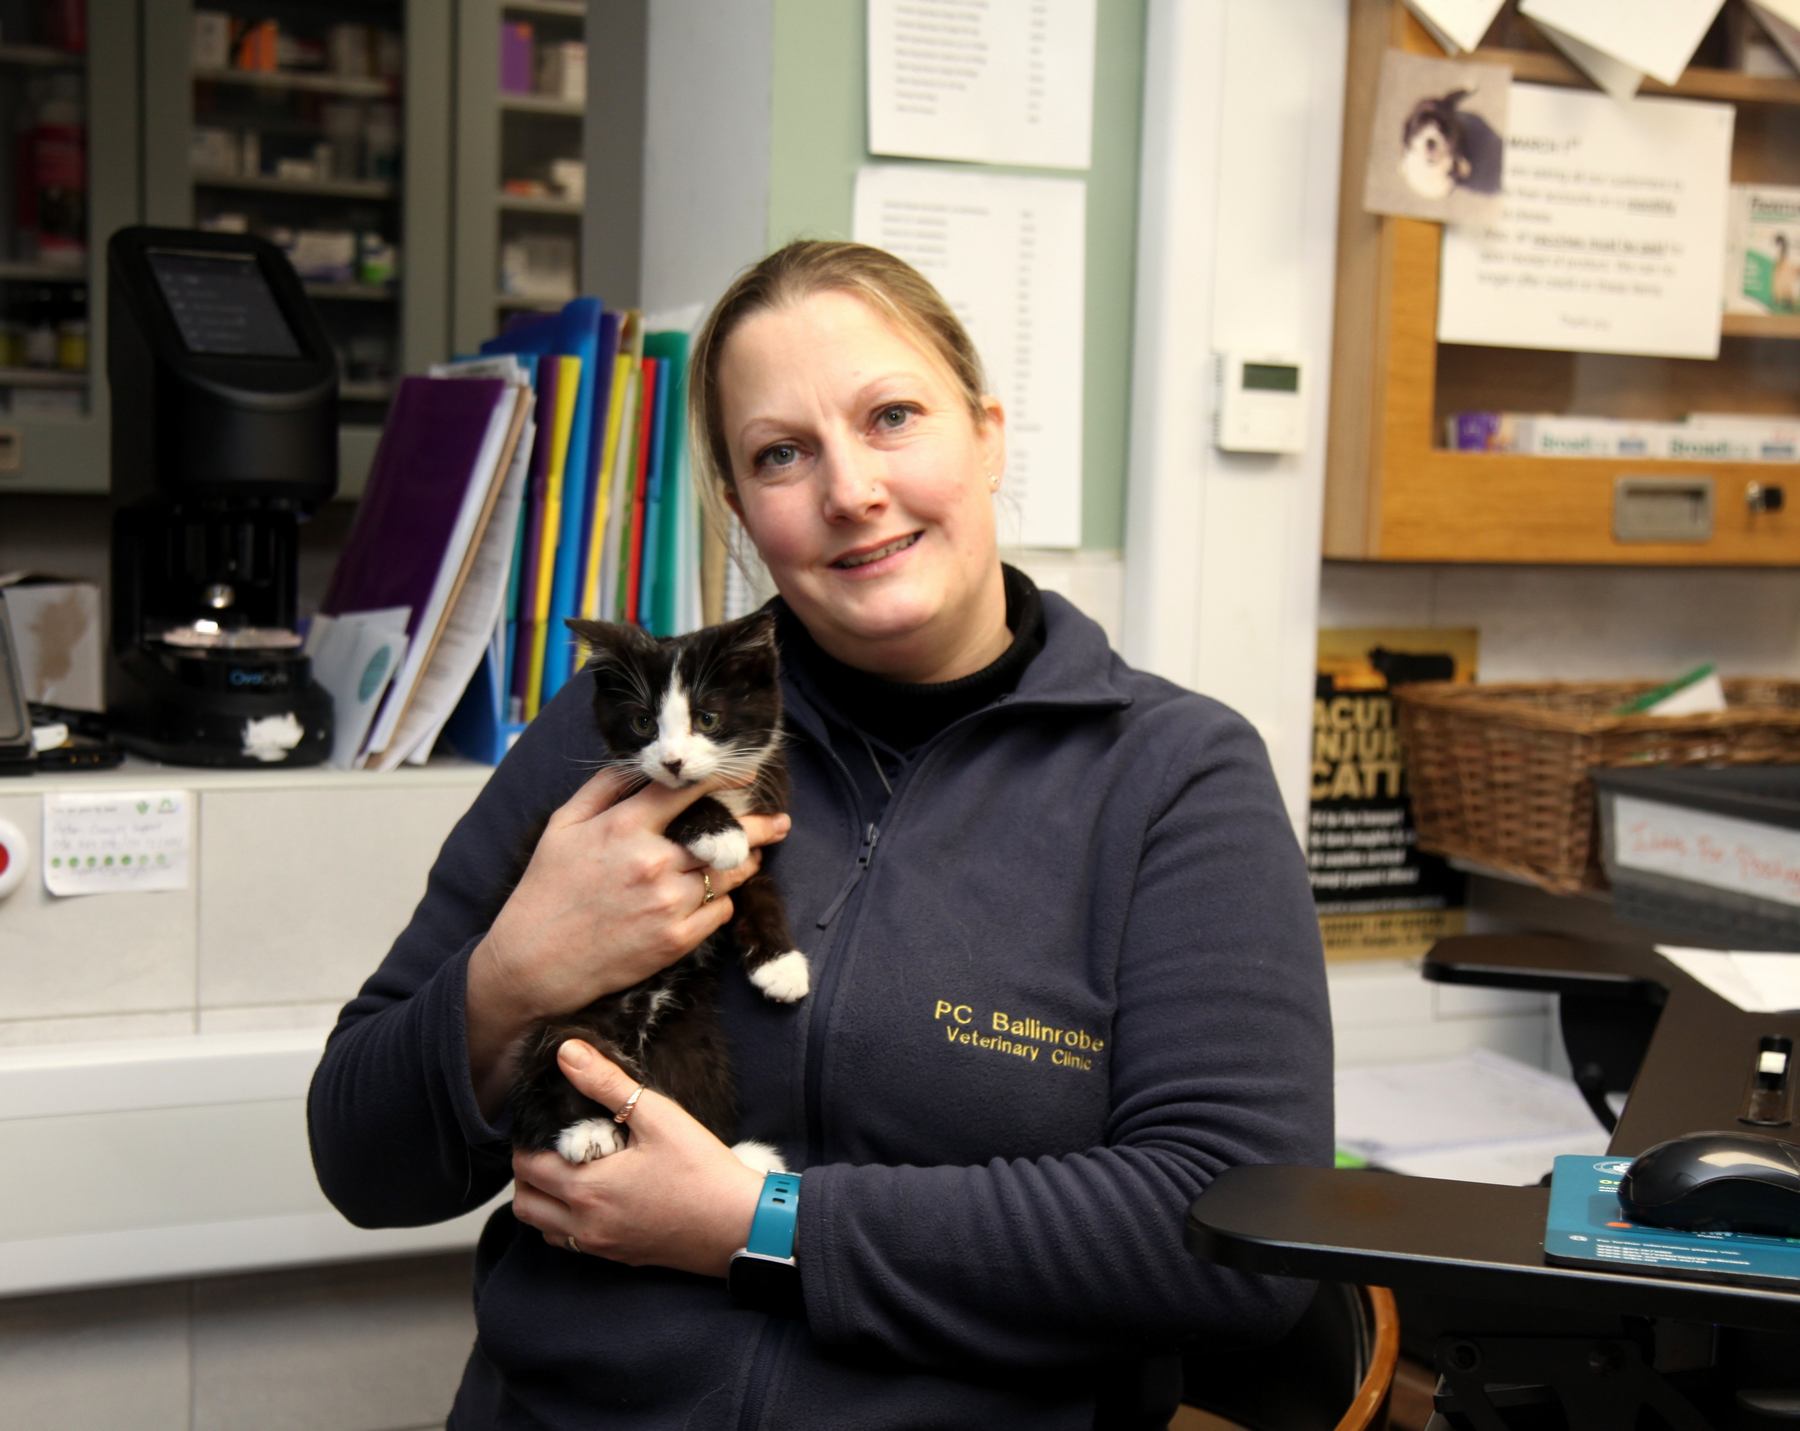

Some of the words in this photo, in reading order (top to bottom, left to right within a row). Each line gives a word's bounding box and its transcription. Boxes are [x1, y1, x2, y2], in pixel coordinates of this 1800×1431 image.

[934, 1000, 973, 1025] PC
[992, 1011, 1105, 1052] Ballinrobe
[946, 1025, 1040, 1062] Veterinary
[1051, 1049, 1092, 1071] Clinic
